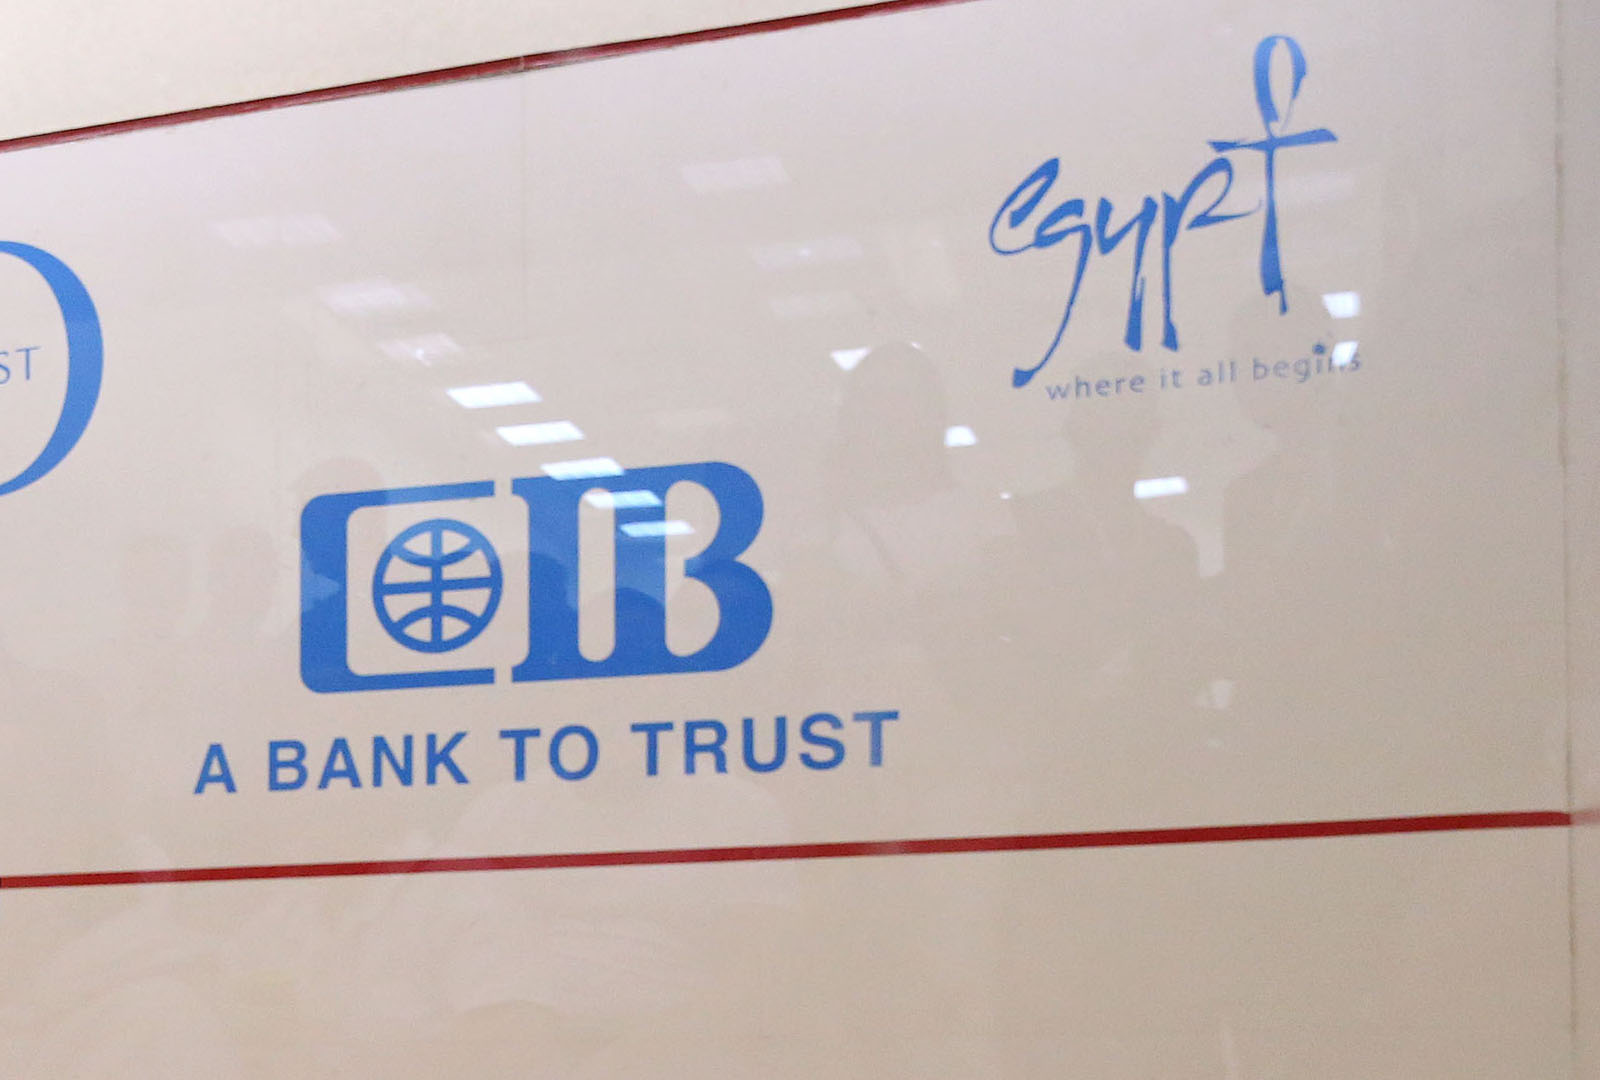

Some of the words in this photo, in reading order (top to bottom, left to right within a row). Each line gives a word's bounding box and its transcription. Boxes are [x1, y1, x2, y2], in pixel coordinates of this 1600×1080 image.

[1046, 373, 1146, 401] where
[1159, 367, 1183, 390] it
[1197, 360, 1238, 387] all
[194, 744, 237, 795] A
[267, 732, 471, 792] BANK
[499, 725, 599, 782] TO
[631, 711, 901, 777] TRUST
